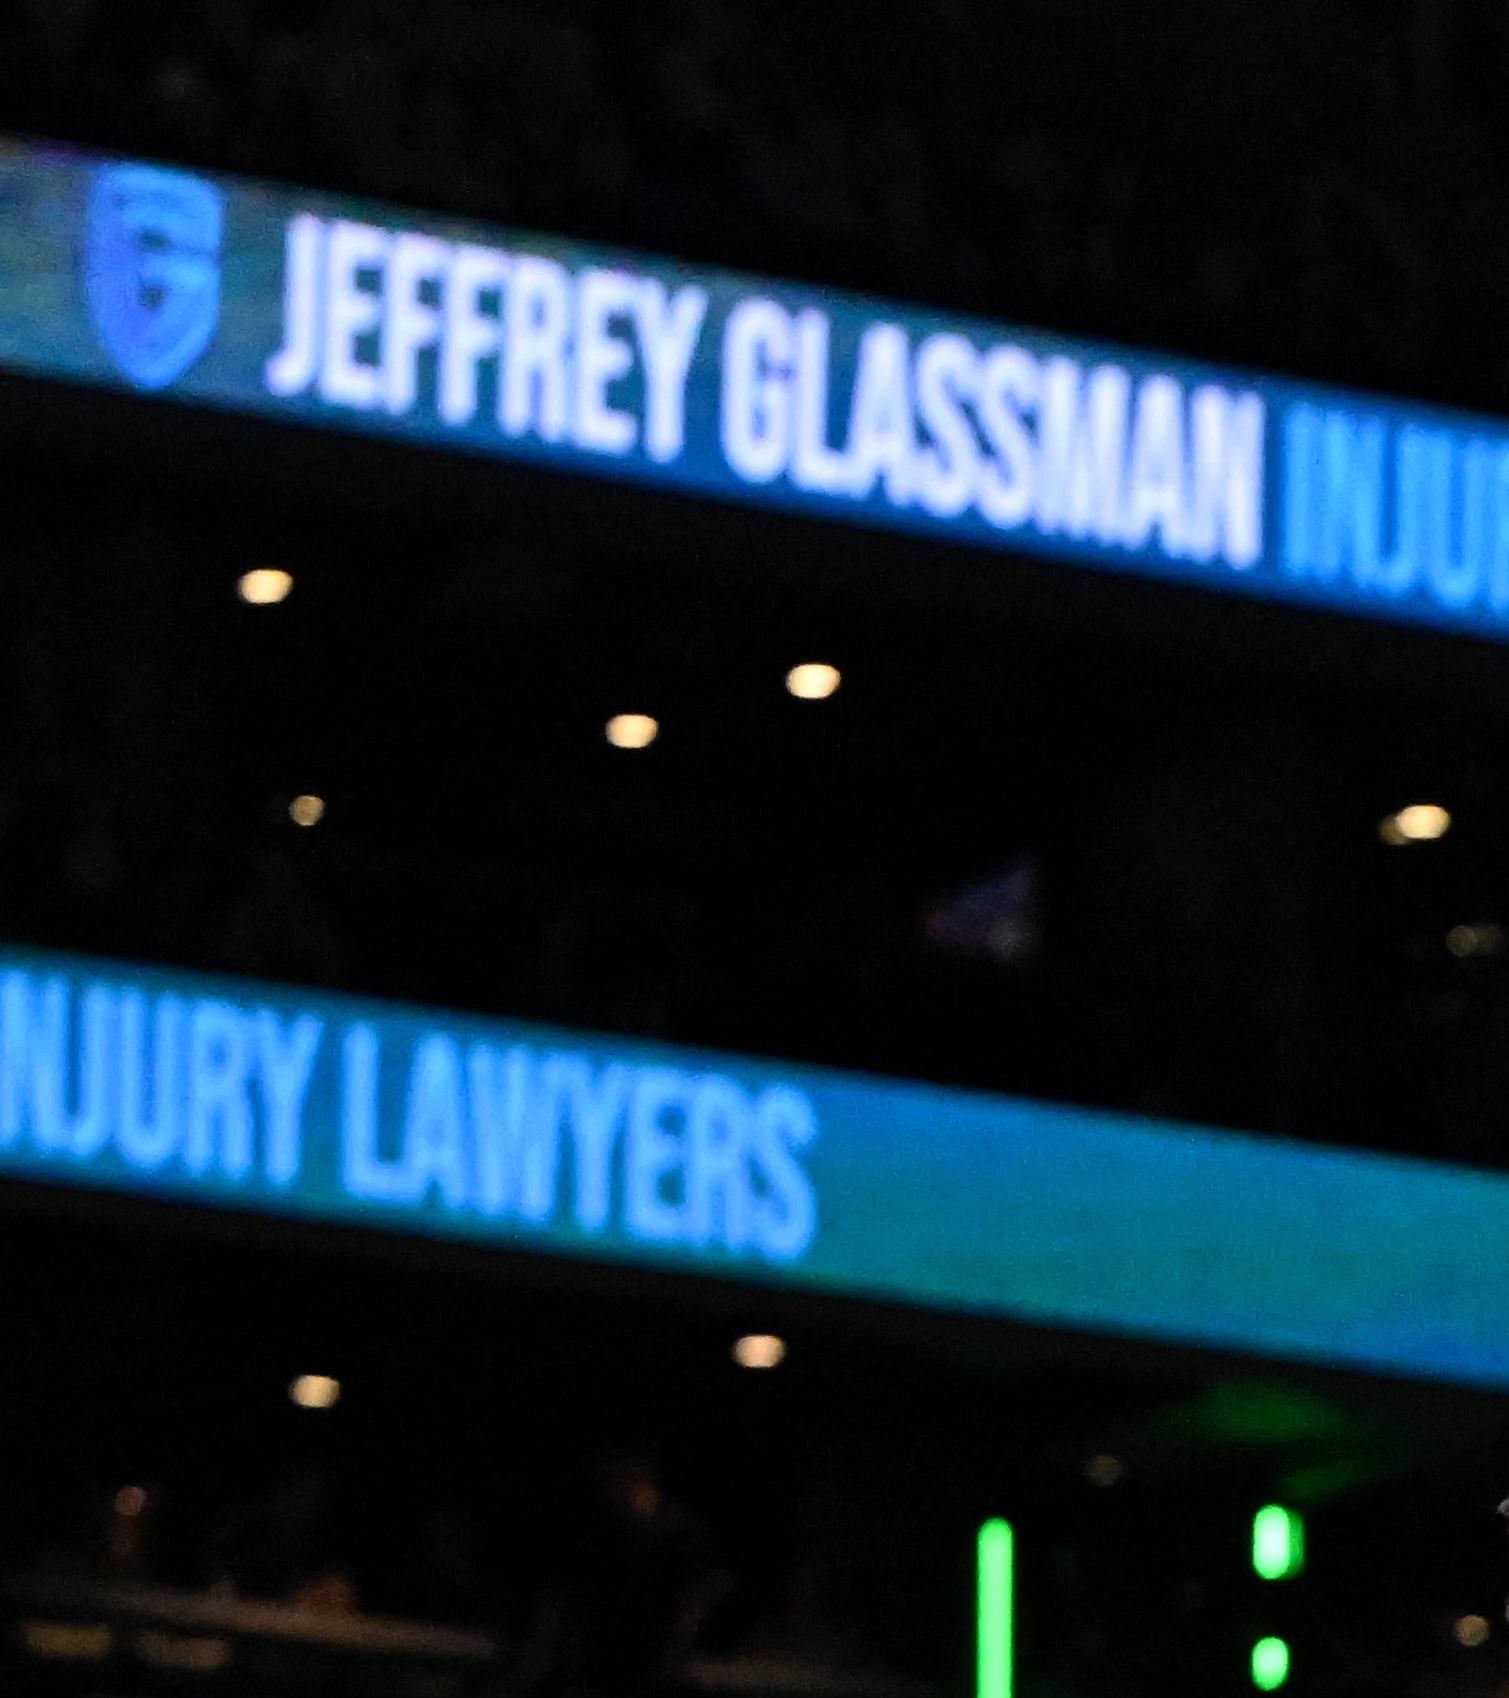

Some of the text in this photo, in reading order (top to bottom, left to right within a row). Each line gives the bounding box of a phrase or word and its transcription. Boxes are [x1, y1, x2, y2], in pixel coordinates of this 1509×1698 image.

[265, 212, 709, 464] JEFFREY
[719, 295, 1267, 571] GLASSMAN
[339, 1017, 817, 1259] LAWYERS
